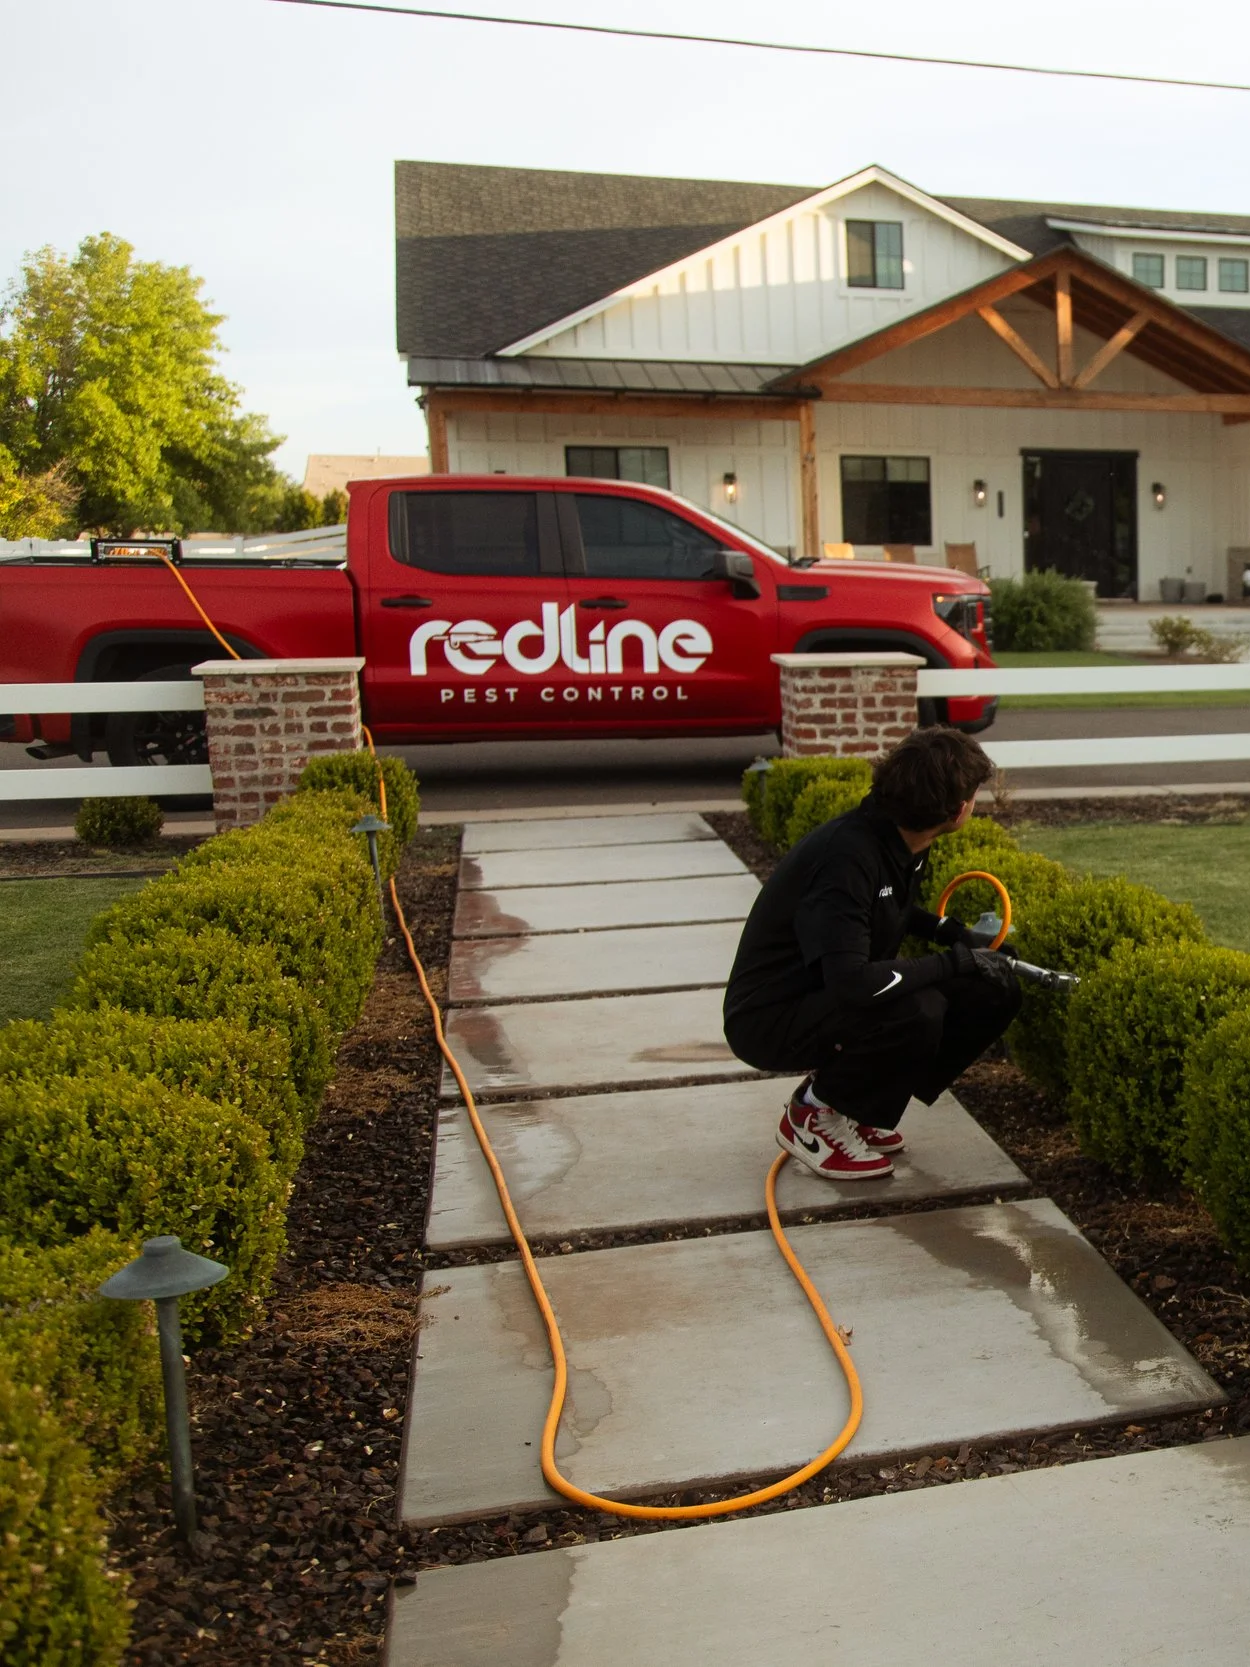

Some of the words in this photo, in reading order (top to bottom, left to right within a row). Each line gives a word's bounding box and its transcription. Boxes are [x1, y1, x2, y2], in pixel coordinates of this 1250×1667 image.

[409, 602, 713, 676] redline
[440, 687, 519, 703] PEST
[540, 685, 689, 702] CONTROL
